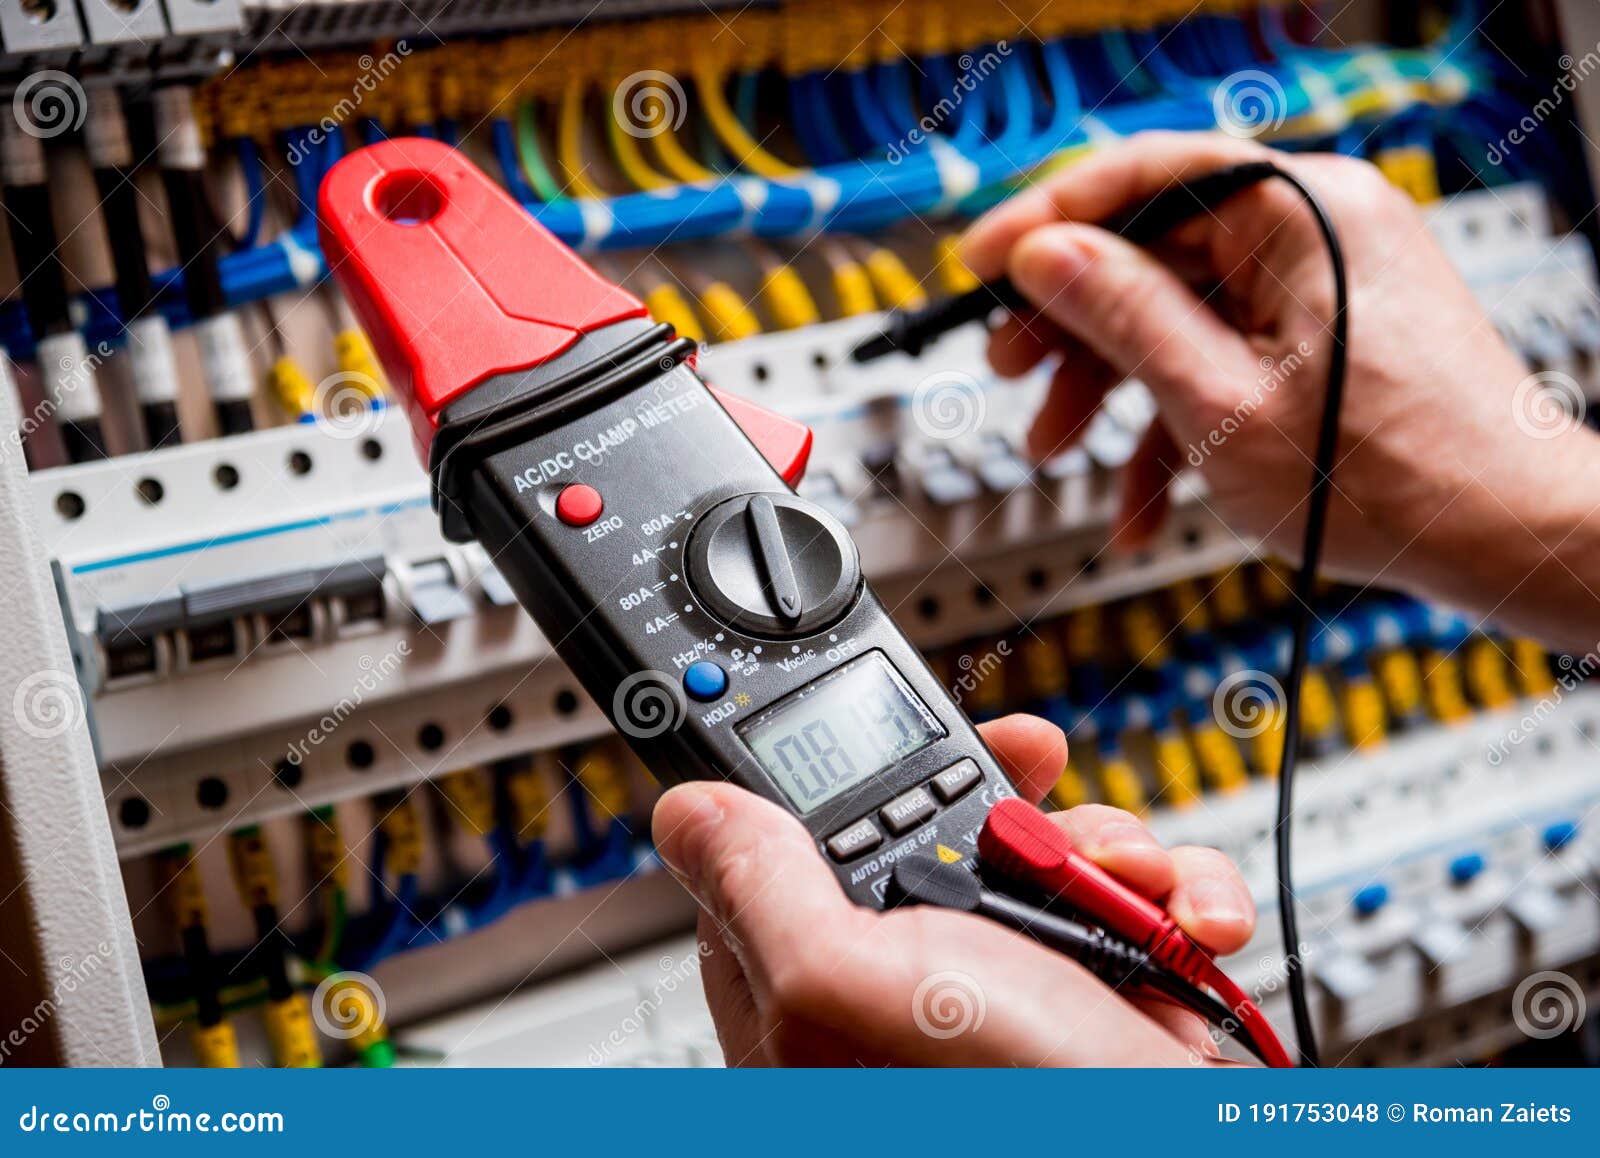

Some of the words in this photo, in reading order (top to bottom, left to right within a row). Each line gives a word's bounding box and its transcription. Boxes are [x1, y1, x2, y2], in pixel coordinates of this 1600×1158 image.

[513, 452, 574, 493] AC/DC
[573, 418, 638, 460] CLAMP
[637, 391, 704, 430] METER
[582, 514, 623, 544] ZERO
[672, 639, 716, 670] Hz/%
[825, 638, 859, 663] OFF
[702, 701, 737, 729] HOLD
[892, 792, 929, 821] RANGE
[838, 824, 874, 850] MODE
[851, 859, 879, 886] AUTO
[879, 838, 918, 869] POWER
[917, 825, 939, 846] OFF
